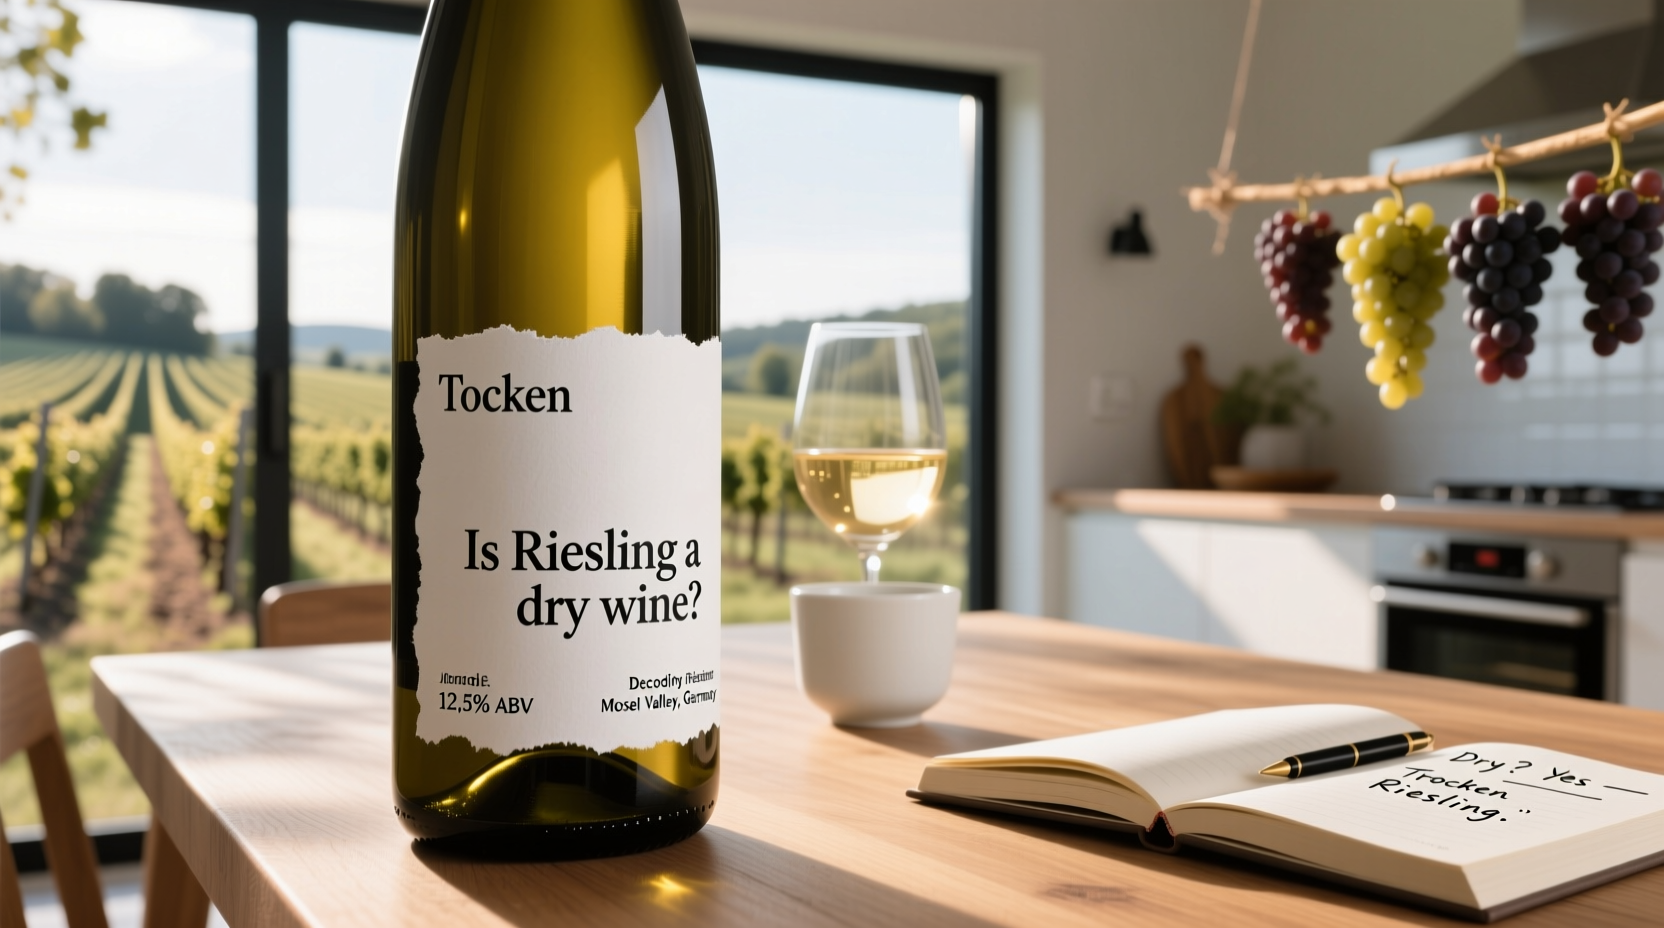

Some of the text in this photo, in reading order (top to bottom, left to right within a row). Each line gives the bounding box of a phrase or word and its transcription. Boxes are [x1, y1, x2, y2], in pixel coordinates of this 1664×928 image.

[438, 373, 573, 413] Tocken
[464, 528, 702, 582] Is Riesling a
[516, 580, 702, 639] dry wine?
[439, 692, 534, 714] 12,5% ABV
[601, 697, 640, 713] Mosel
[645, 694, 681, 711] Valley,
[1405, 766, 1508, 800] Trocken
[1543, 767, 1591, 786] Yes
